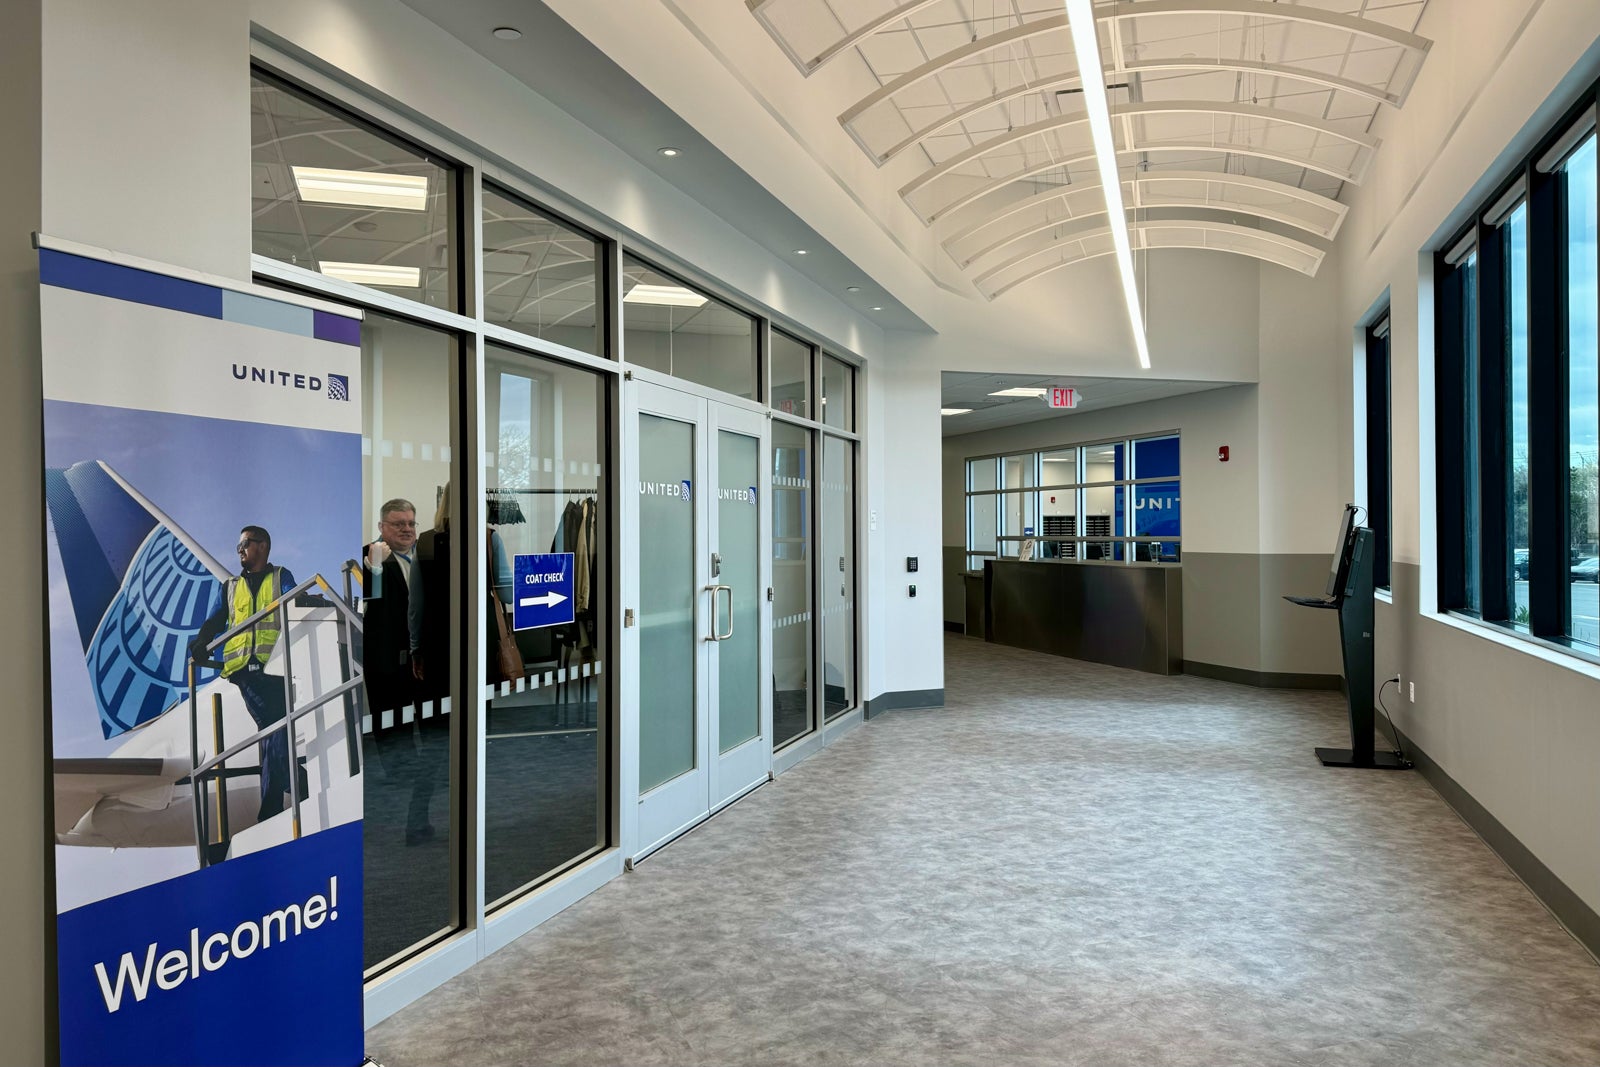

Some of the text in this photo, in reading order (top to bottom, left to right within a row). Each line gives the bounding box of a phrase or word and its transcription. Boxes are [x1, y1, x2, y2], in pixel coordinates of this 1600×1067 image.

[232, 363, 322, 391] UNITED
[1053, 388, 1074, 407] EXIT
[639, 481, 680, 497] UNITED
[718, 488, 748, 501] UNITED
[525, 572, 564, 585] COAT CHECK
[94, 875, 339, 1014] Welcome!
